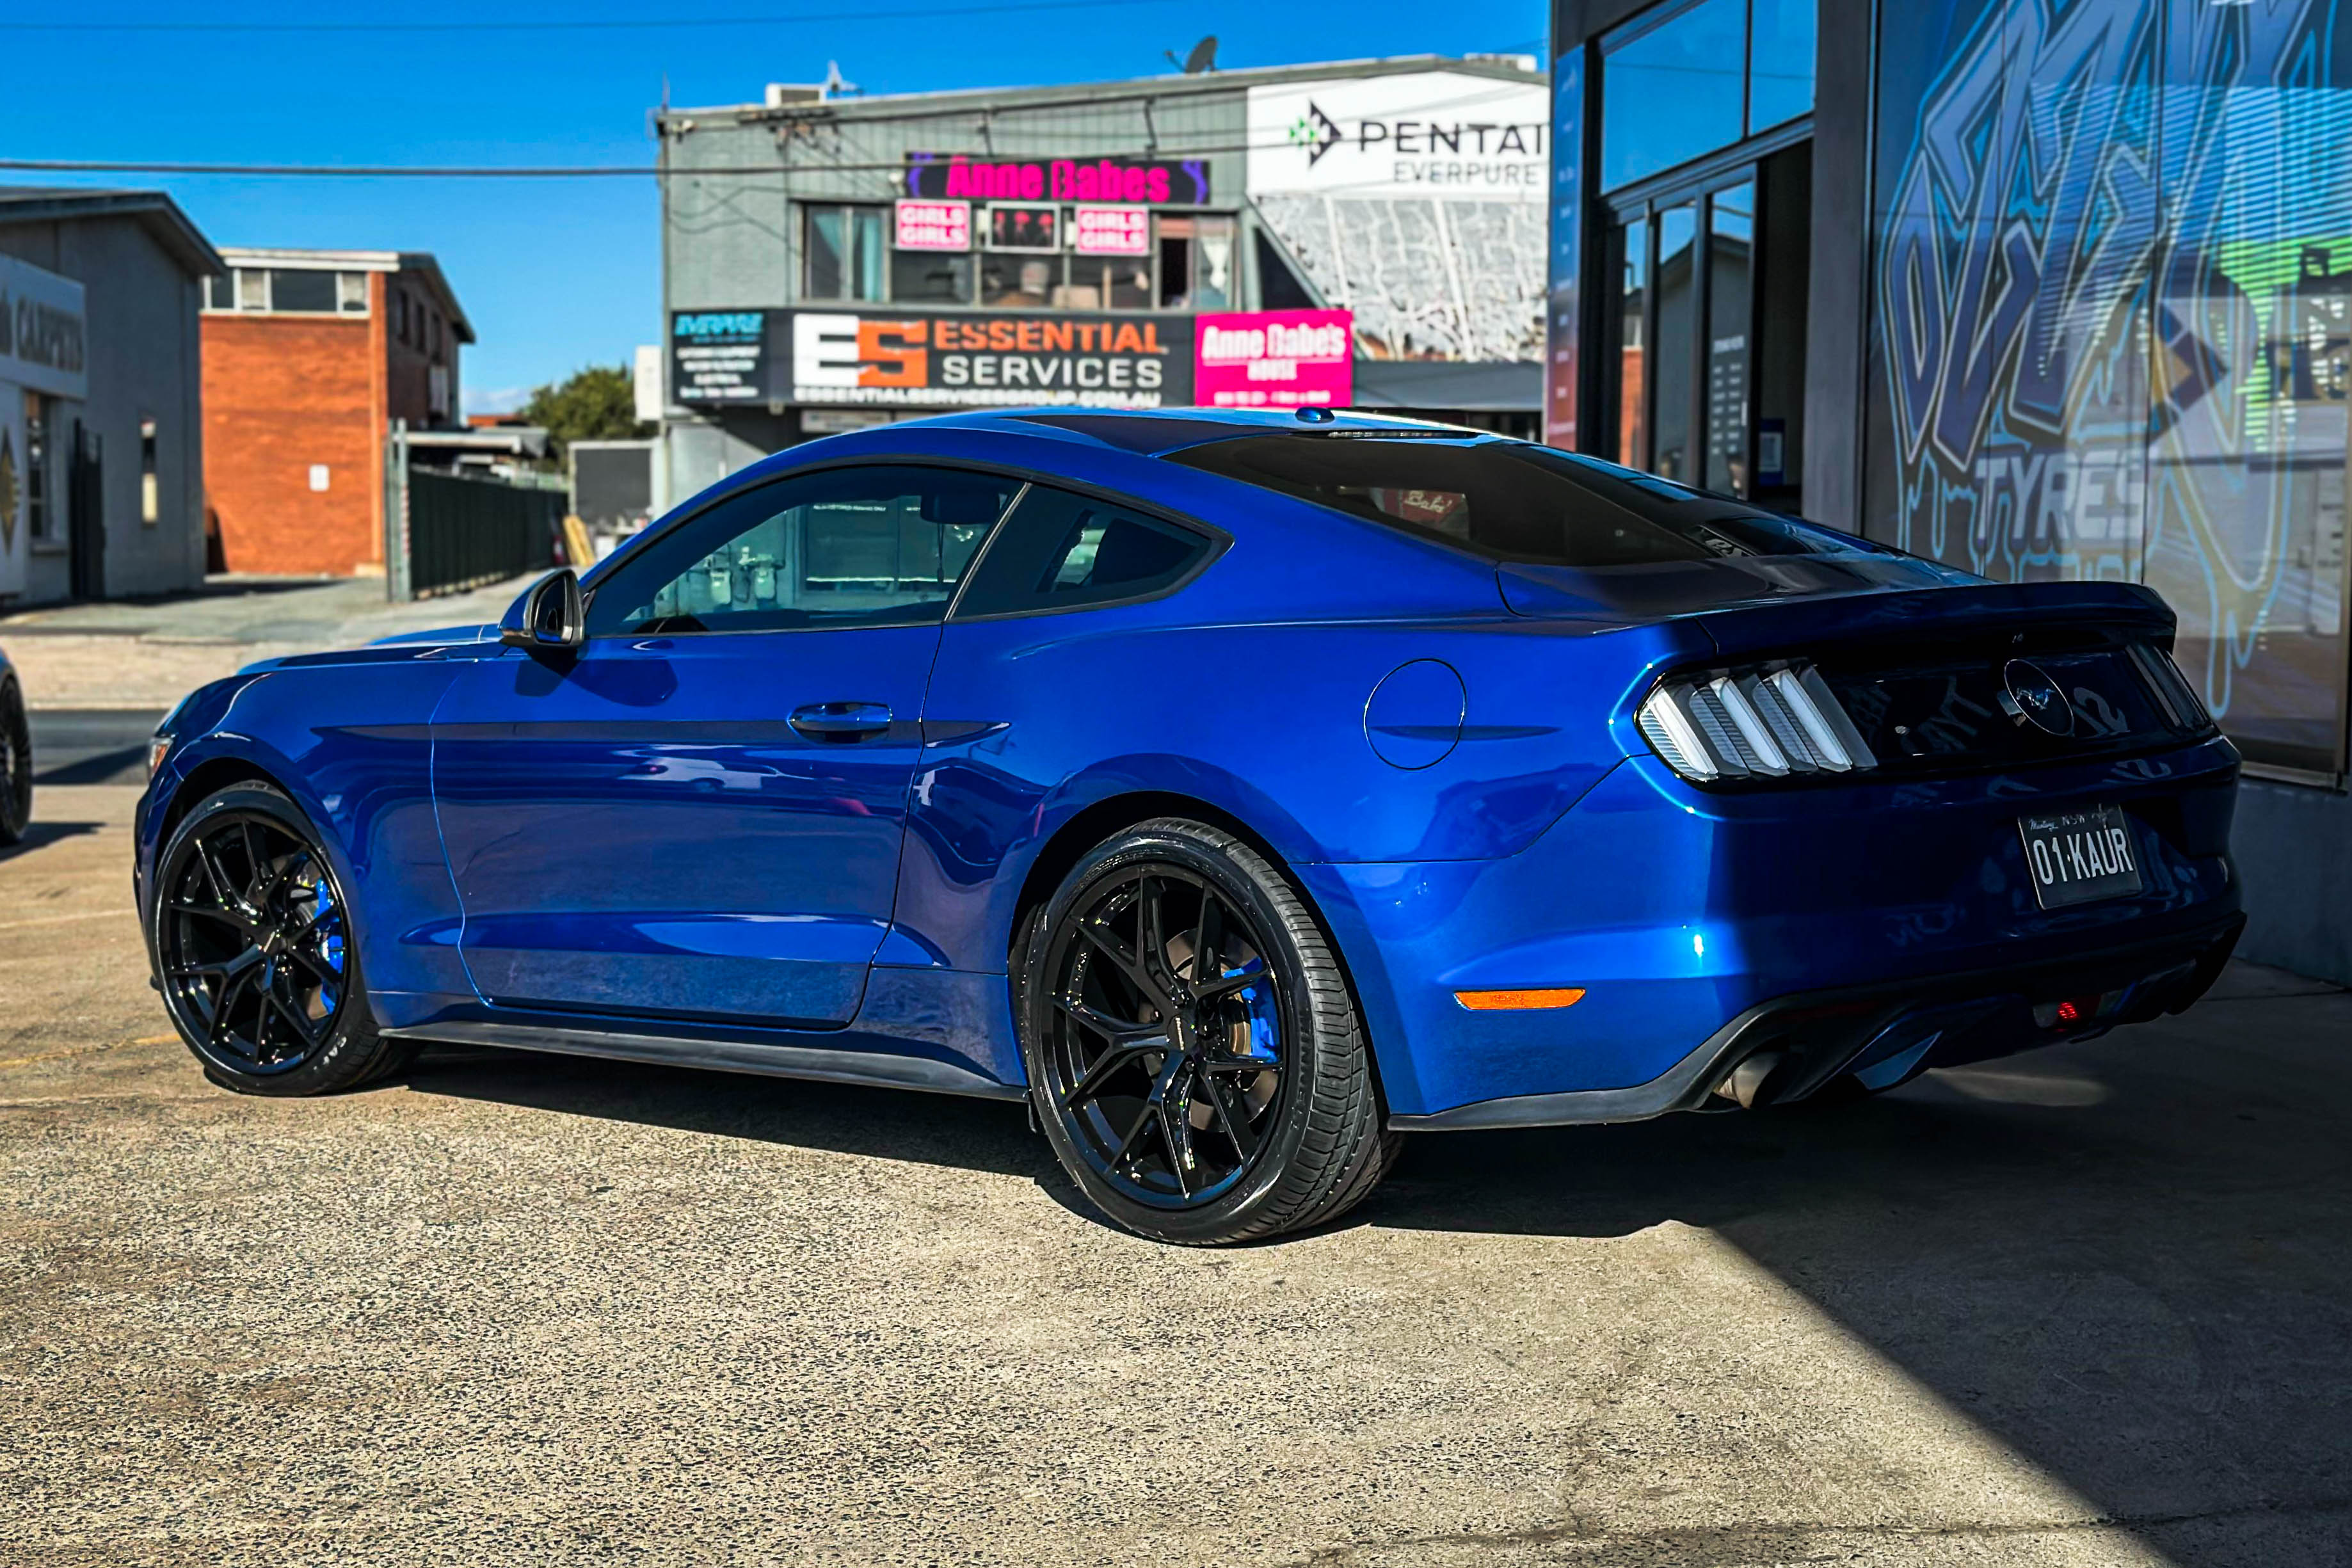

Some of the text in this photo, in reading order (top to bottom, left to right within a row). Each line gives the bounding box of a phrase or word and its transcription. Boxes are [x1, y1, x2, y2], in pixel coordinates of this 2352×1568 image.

[947, 156, 1170, 203] Anne Babes
[1393, 162, 1539, 186] EVERPURE
[900, 207, 966, 225] GIRLS
[1080, 212, 1144, 230] GIRLS
[900, 225, 966, 244] GIRLS
[1080, 230, 1144, 249] GIRLS
[934, 319, 1164, 353] ESSENTIAL
[1201, 325, 1266, 359] Anne
[942, 355, 1162, 388] SERVICES
[1975, 449, 2145, 540] TYRES
